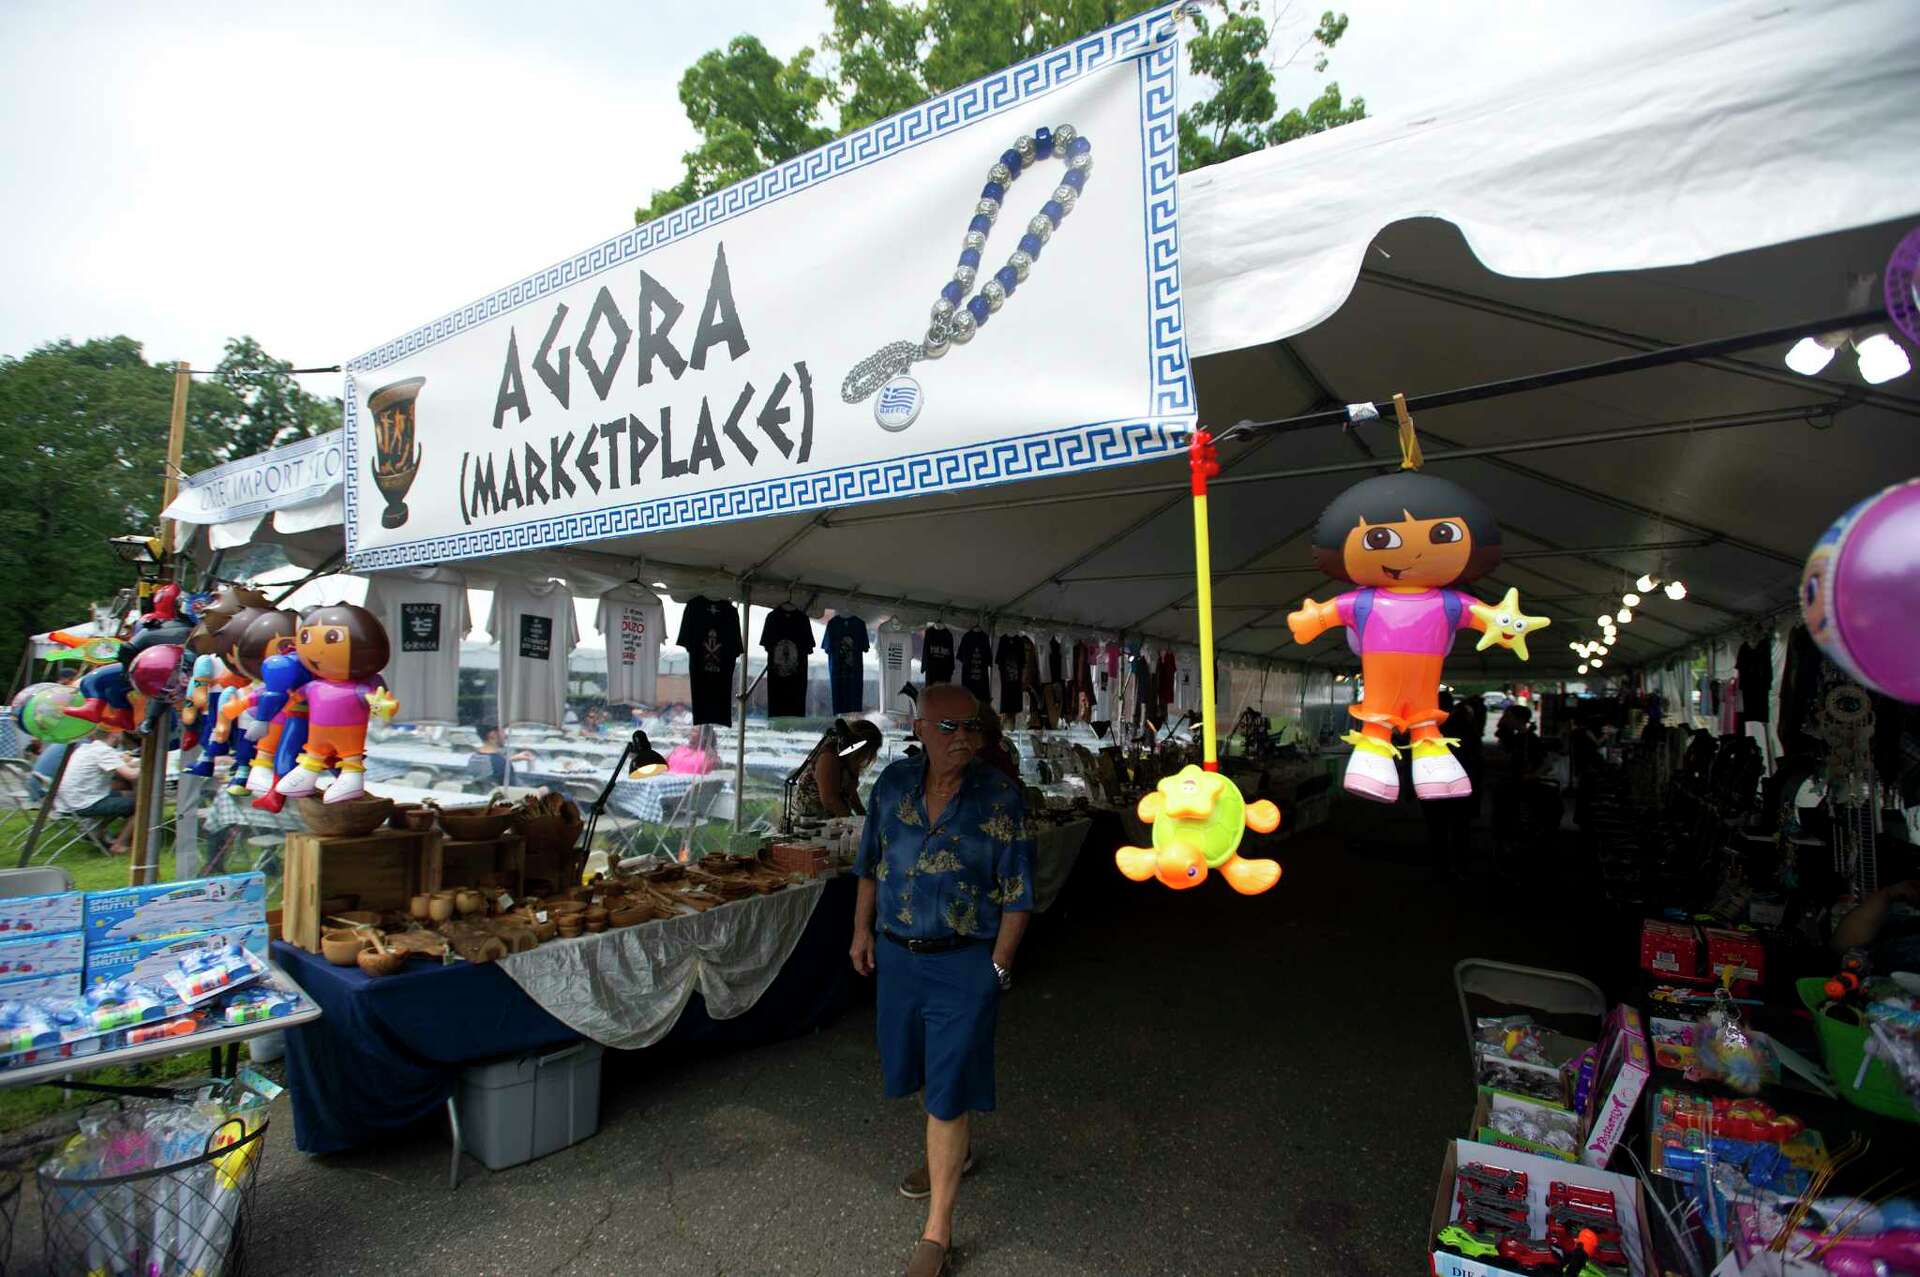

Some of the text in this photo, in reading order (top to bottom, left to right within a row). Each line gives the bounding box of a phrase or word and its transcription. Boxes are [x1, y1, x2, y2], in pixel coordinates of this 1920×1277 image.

[493, 240, 750, 429] AGORA
[460, 360, 814, 525] (MARKETPLACE)
[233, 460, 304, 499] IMPORT
[88, 900, 140, 913] SHUTTLE
[88, 954, 140, 968] SHUTTLE
